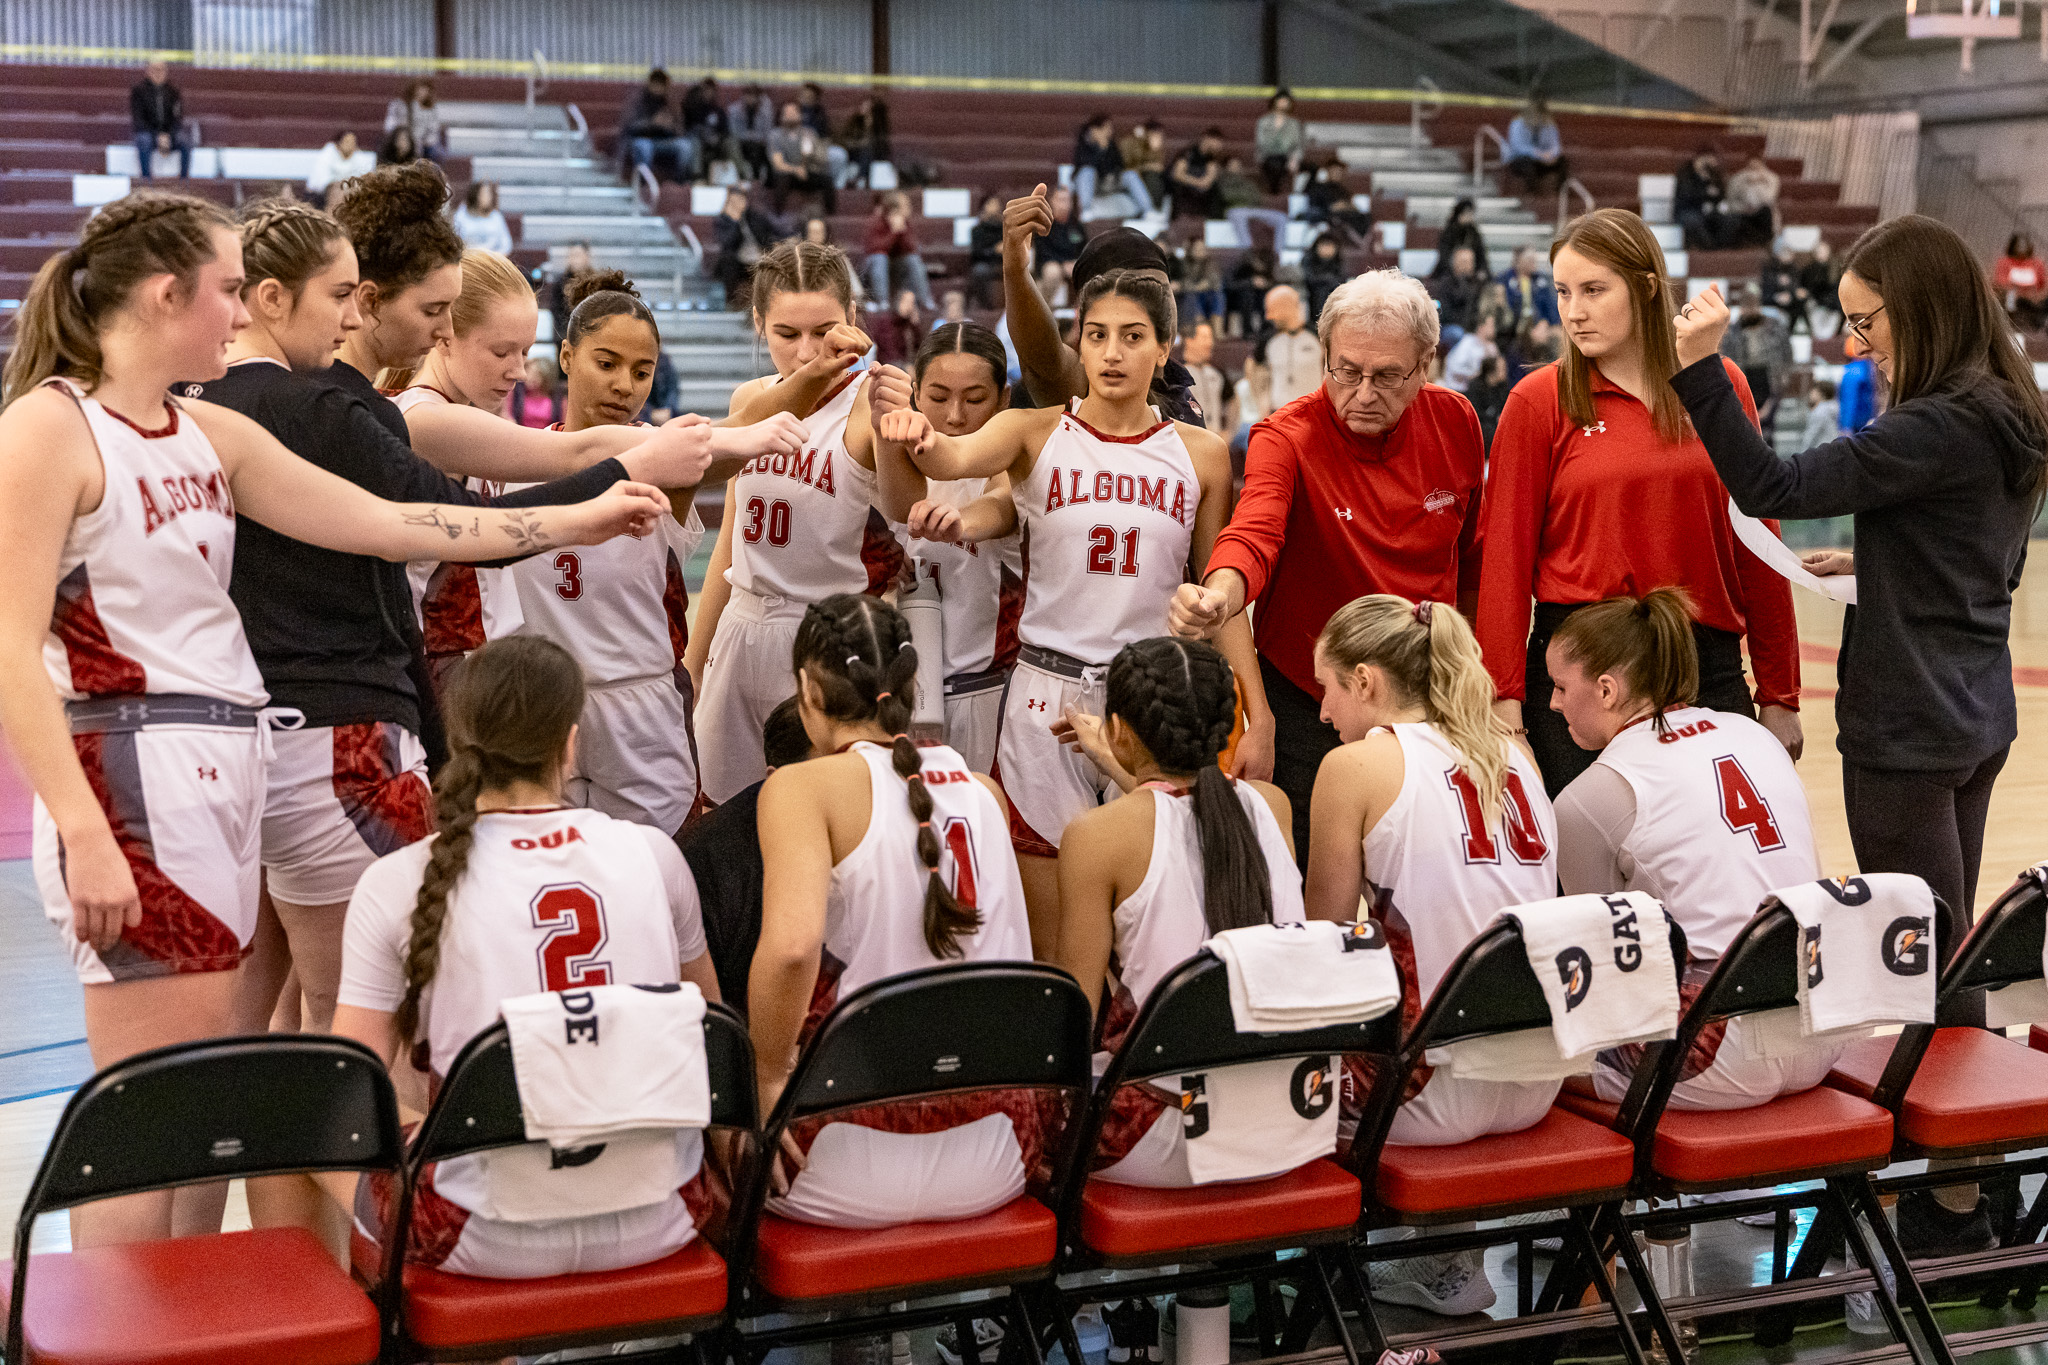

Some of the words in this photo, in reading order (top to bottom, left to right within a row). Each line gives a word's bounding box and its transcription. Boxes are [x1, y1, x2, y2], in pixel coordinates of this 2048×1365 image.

[736, 447, 836, 498] GOMA
[1045, 467, 1185, 528] ALGOMA
[136, 470, 236, 538] AGOM
[742, 496, 792, 548] 30
[554, 551, 583, 601] 3
[1087, 524, 1140, 577] 21
[1657, 720, 1718, 744] OUA
[919, 770, 971, 786] UA
[1712, 754, 1787, 854] 4
[510, 825, 587, 850] OUA
[1444, 763, 1550, 866] 10
[530, 881, 614, 993] 2
[1881, 916, 1932, 977] G
[1290, 1055, 1334, 1120] G
